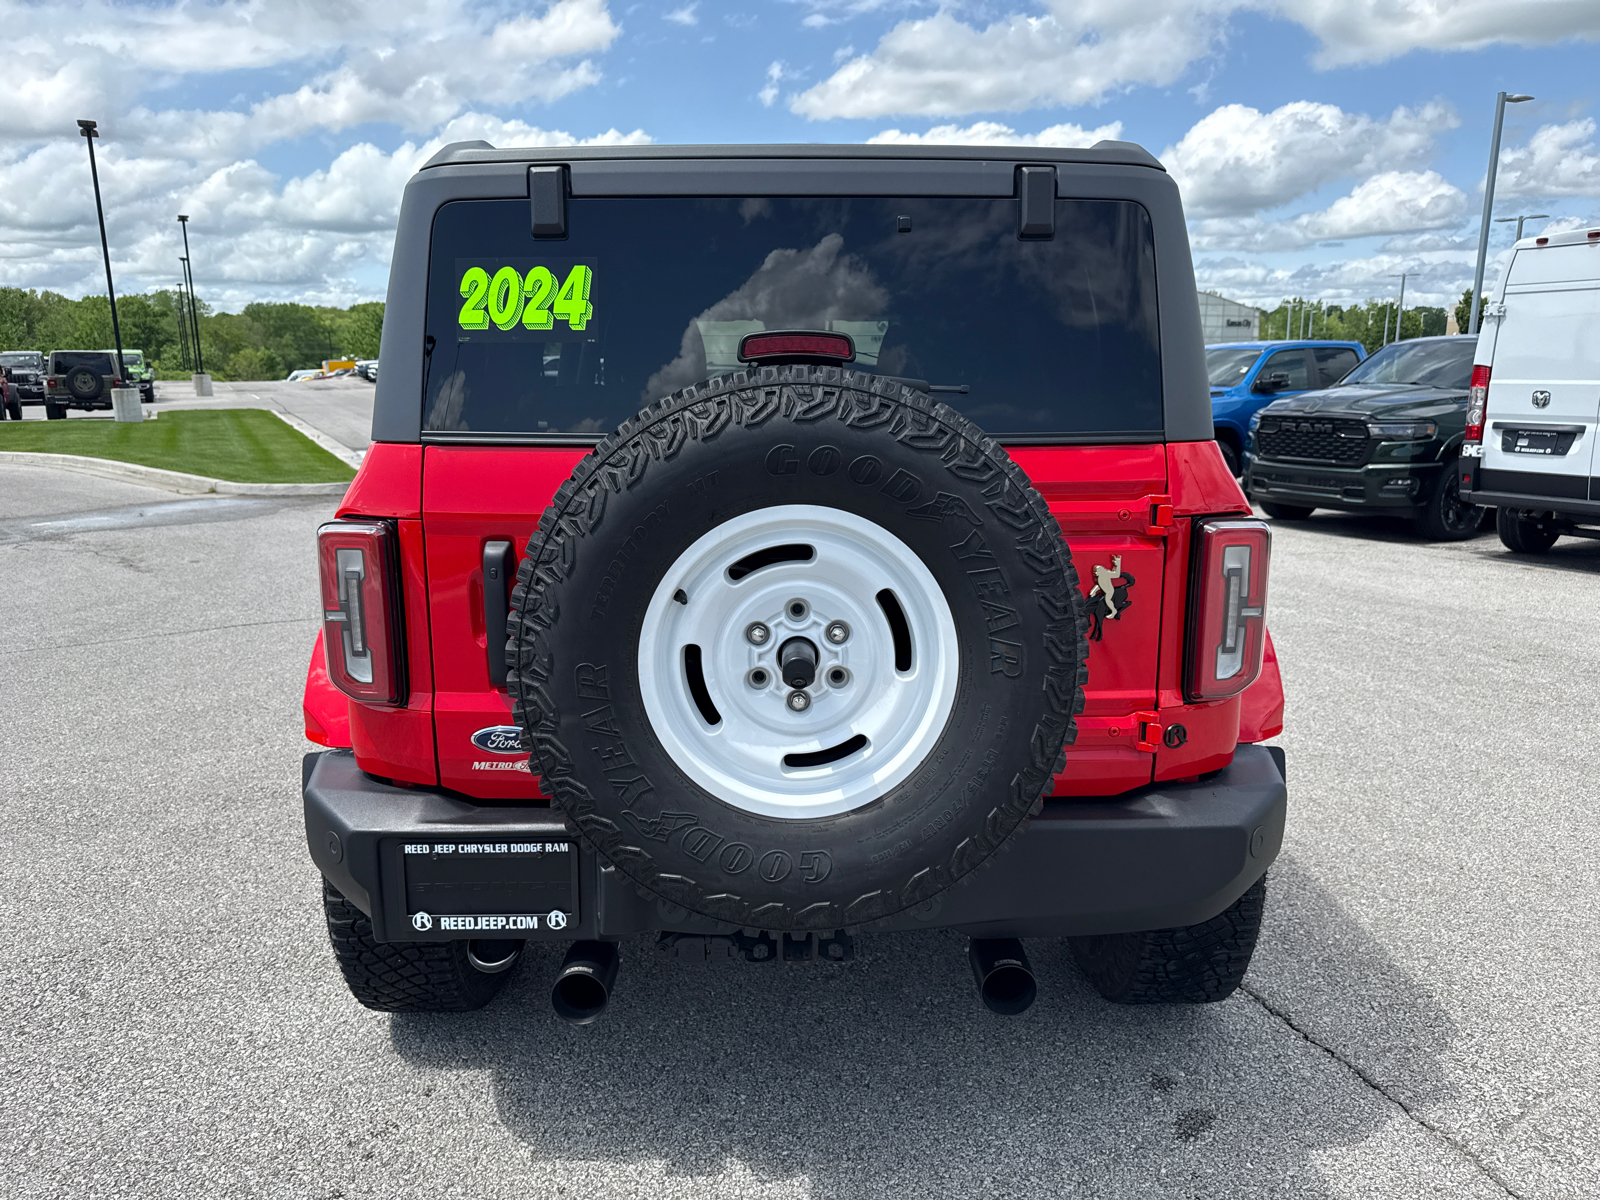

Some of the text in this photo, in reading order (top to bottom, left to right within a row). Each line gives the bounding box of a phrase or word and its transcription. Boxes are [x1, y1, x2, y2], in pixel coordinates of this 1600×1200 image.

[458, 265, 594, 331] 2024
[1281, 421, 1333, 433] RAM
[590, 499, 671, 621] TERRITORY
[764, 443, 1024, 677] GOOD YEAR
[472, 761, 513, 770] METRO
[404, 843, 569, 854] REED JEEP CHRYSLER DODGE RAM
[440, 916, 538, 930] REEDJEEP.COM
